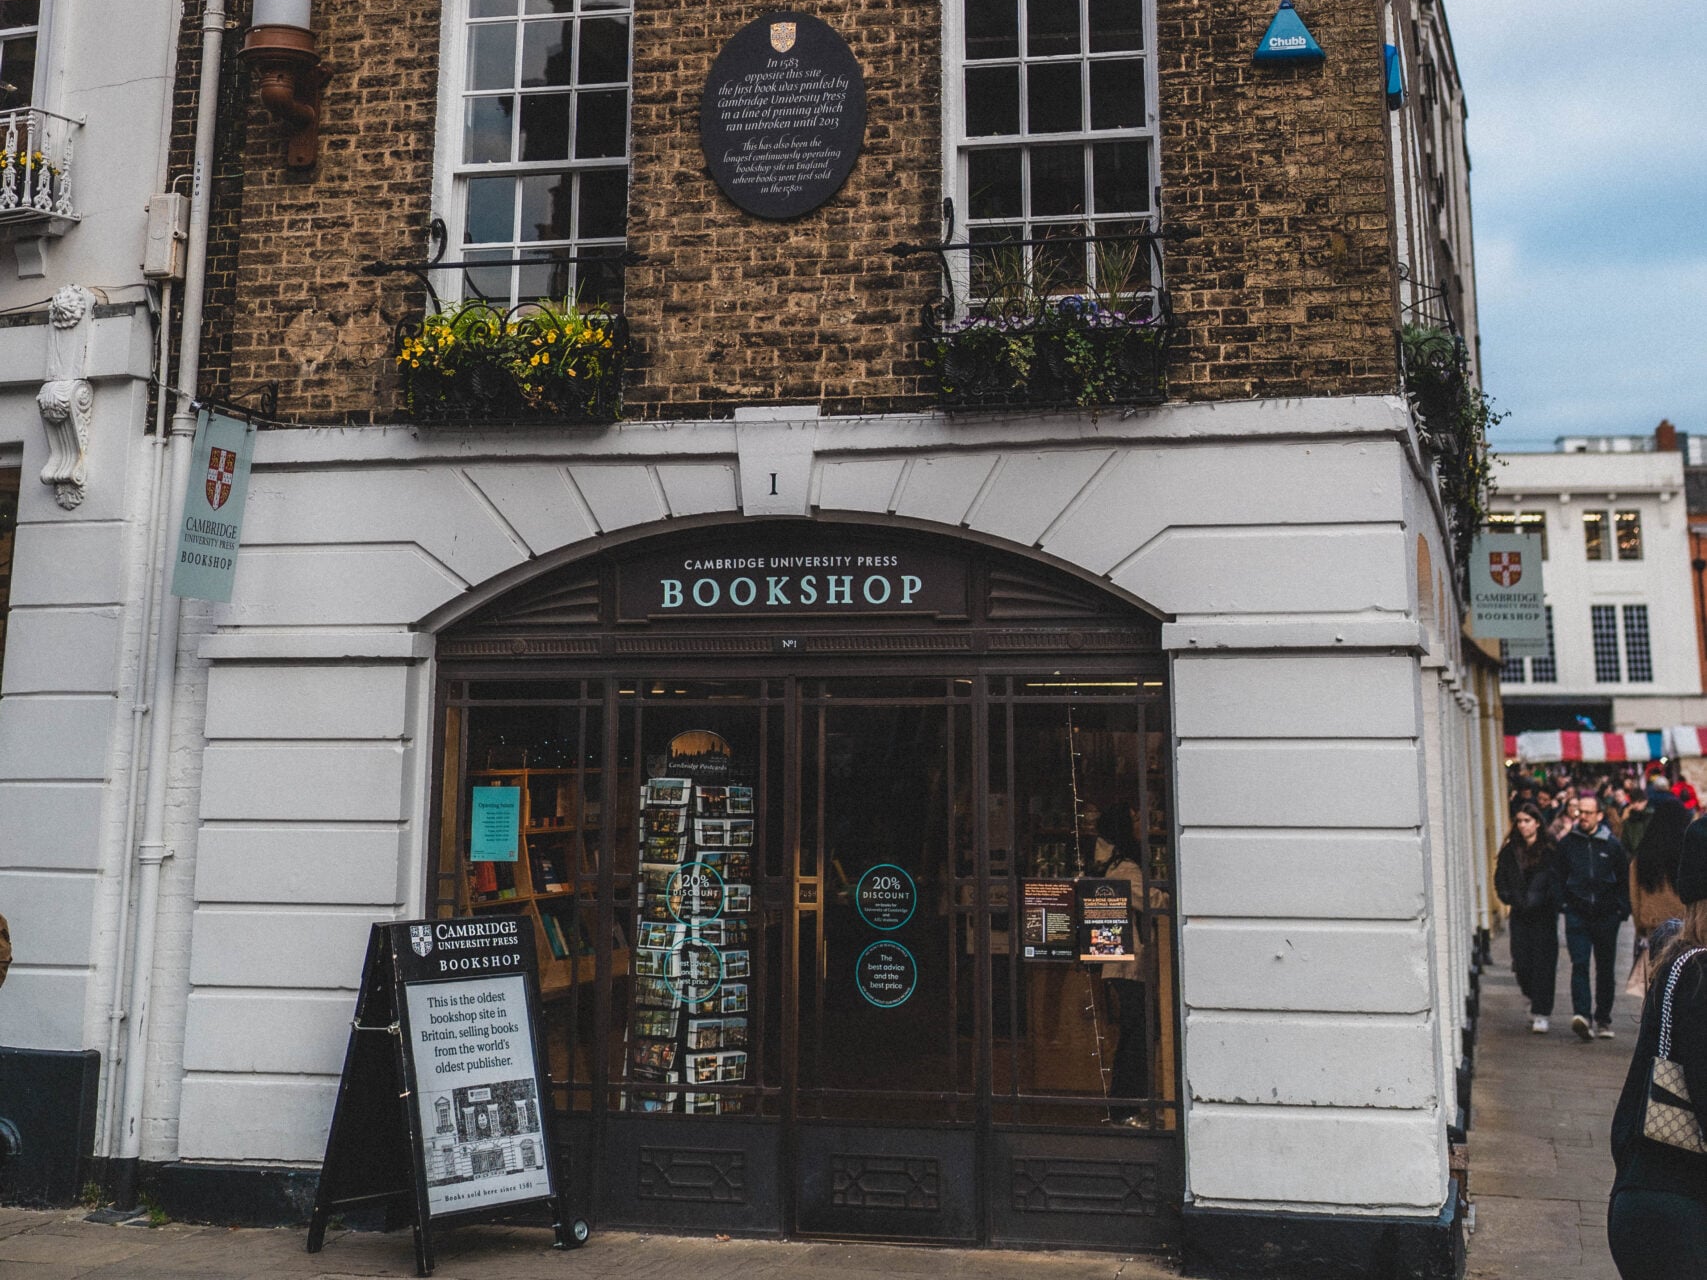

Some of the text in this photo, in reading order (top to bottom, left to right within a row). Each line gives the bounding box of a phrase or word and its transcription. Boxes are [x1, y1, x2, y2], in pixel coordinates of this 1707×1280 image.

[1269, 36, 1306, 46] Chubb
[767, 58, 799, 69] In 1583
[745, 68, 822, 84] opposite this site
[718, 75, 849, 97] the first book was printed by
[718, 92, 846, 110] Cambridge University Press
[721, 100, 843, 120] in a line of printing which
[726, 116, 840, 132] ran unbroken until 2013
[742, 133, 822, 151] This has also been the
[724, 148, 841, 164] longest continuously operating
[736, 162, 772, 174] bookshop
[773, 162, 786, 172] site
[796, 160, 829, 170] England
[732, 169, 834, 184] where books were first sold
[770, 182, 782, 193] the
[782, 185, 803, 197] 1580s
[186, 516, 238, 539] CAMBRIDGE
[184, 534, 235, 550] UNIVERSITY PRESS
[181, 551, 232, 570] BOOKSHOP
[684, 556, 898, 570] CAMBRIDGE UNIVERSITY PRESS
[660, 575, 923, 608] BOOKSHOP
[1476, 593, 1538, 602] CAMBRIDGE
[682, 874, 710, 888] 20%
[872, 876, 900, 890] 20%
[863, 892, 910, 900] DISCOUNT
[436, 922, 518, 940] CAMBRIDGE
[438, 936, 518, 950] UNIVERSITY PRESS
[440, 954, 520, 972] BOOKSHOP
[427, 992, 506, 1008] This is the oldest
[430, 1007, 507, 1024] bookshop site in
[421, 1022, 519, 1042] Britain, selling books
[434, 1039, 510, 1057] from the world's
[436, 1056, 513, 1074] oldest publisher.
[444, 1193, 465, 1202] Books
[467, 1190, 481, 1199] sold
[500, 1185, 516, 1193] since
